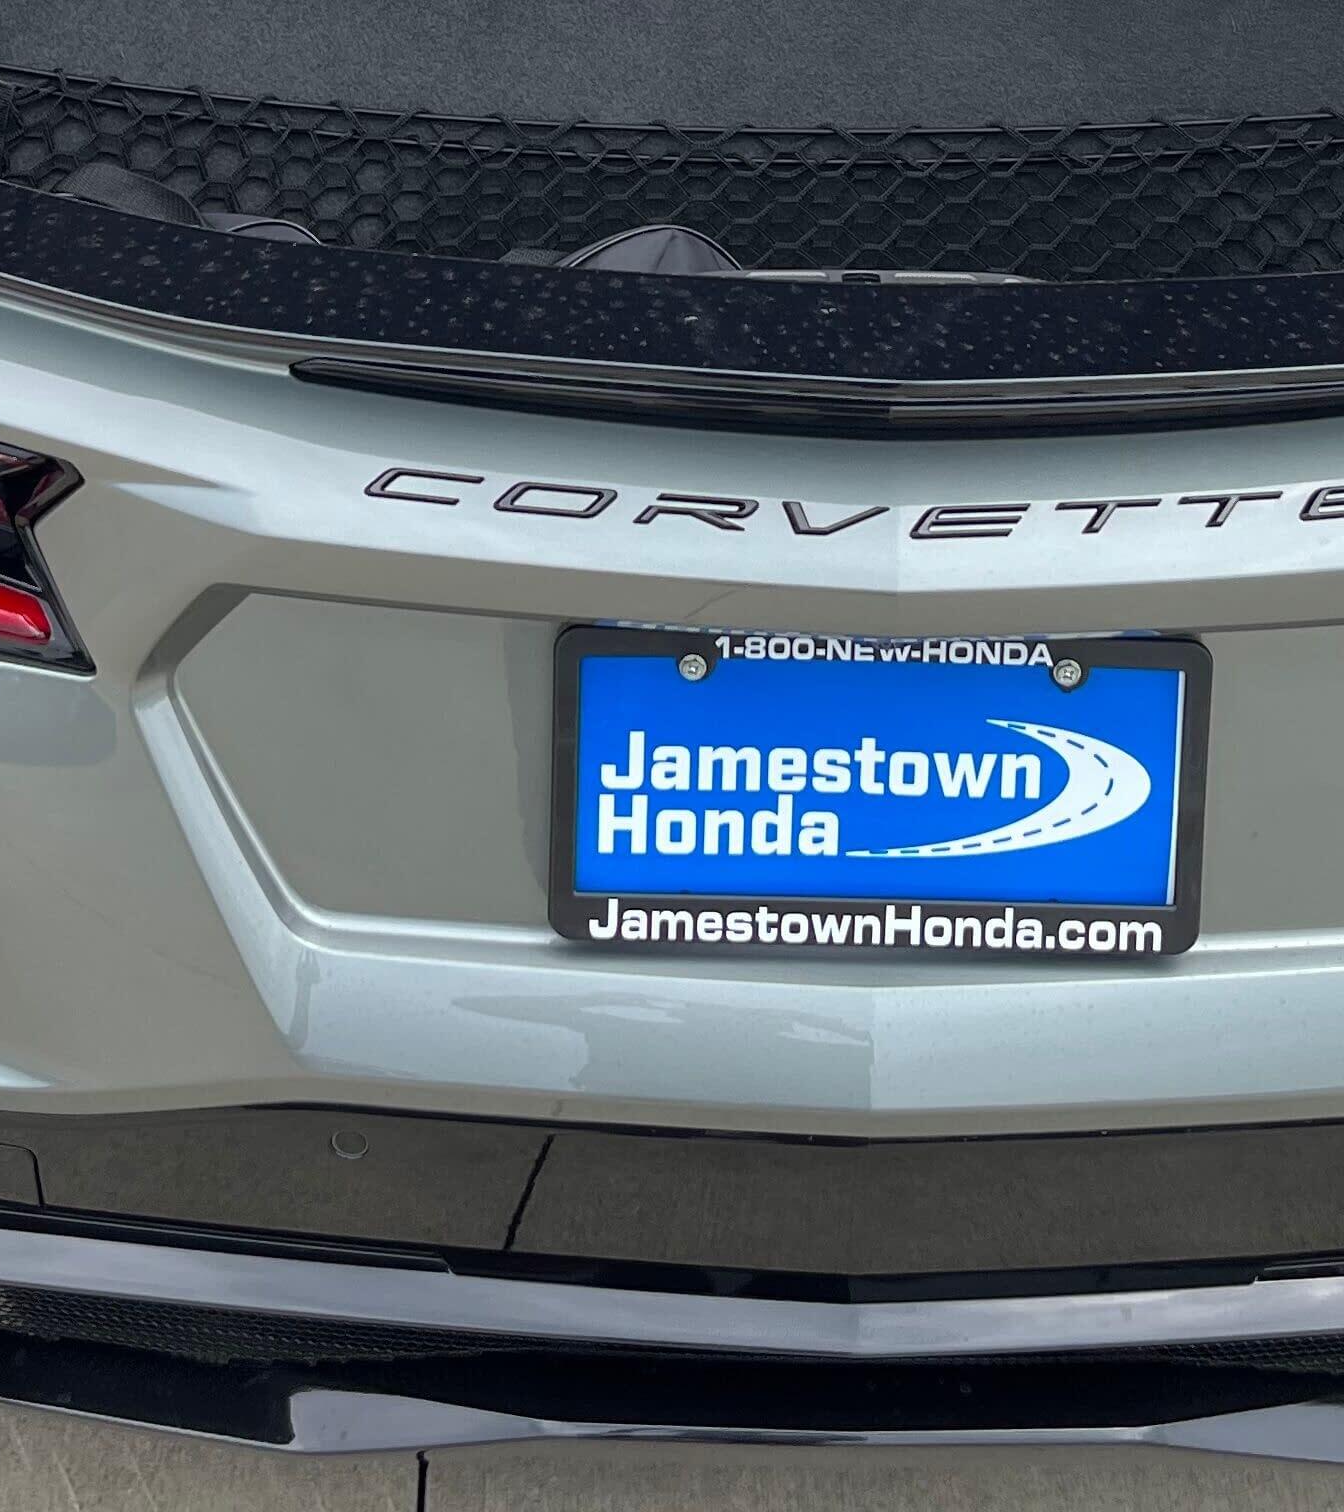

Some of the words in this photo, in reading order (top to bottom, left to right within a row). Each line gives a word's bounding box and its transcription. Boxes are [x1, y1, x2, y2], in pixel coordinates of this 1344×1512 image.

[714, 635, 1054, 668] 1-800-NEW-HONDA
[600, 730, 1042, 800] Jamestown
[597, 793, 840, 857] Honda
[588, 897, 1163, 953] JamestownHonda.com
